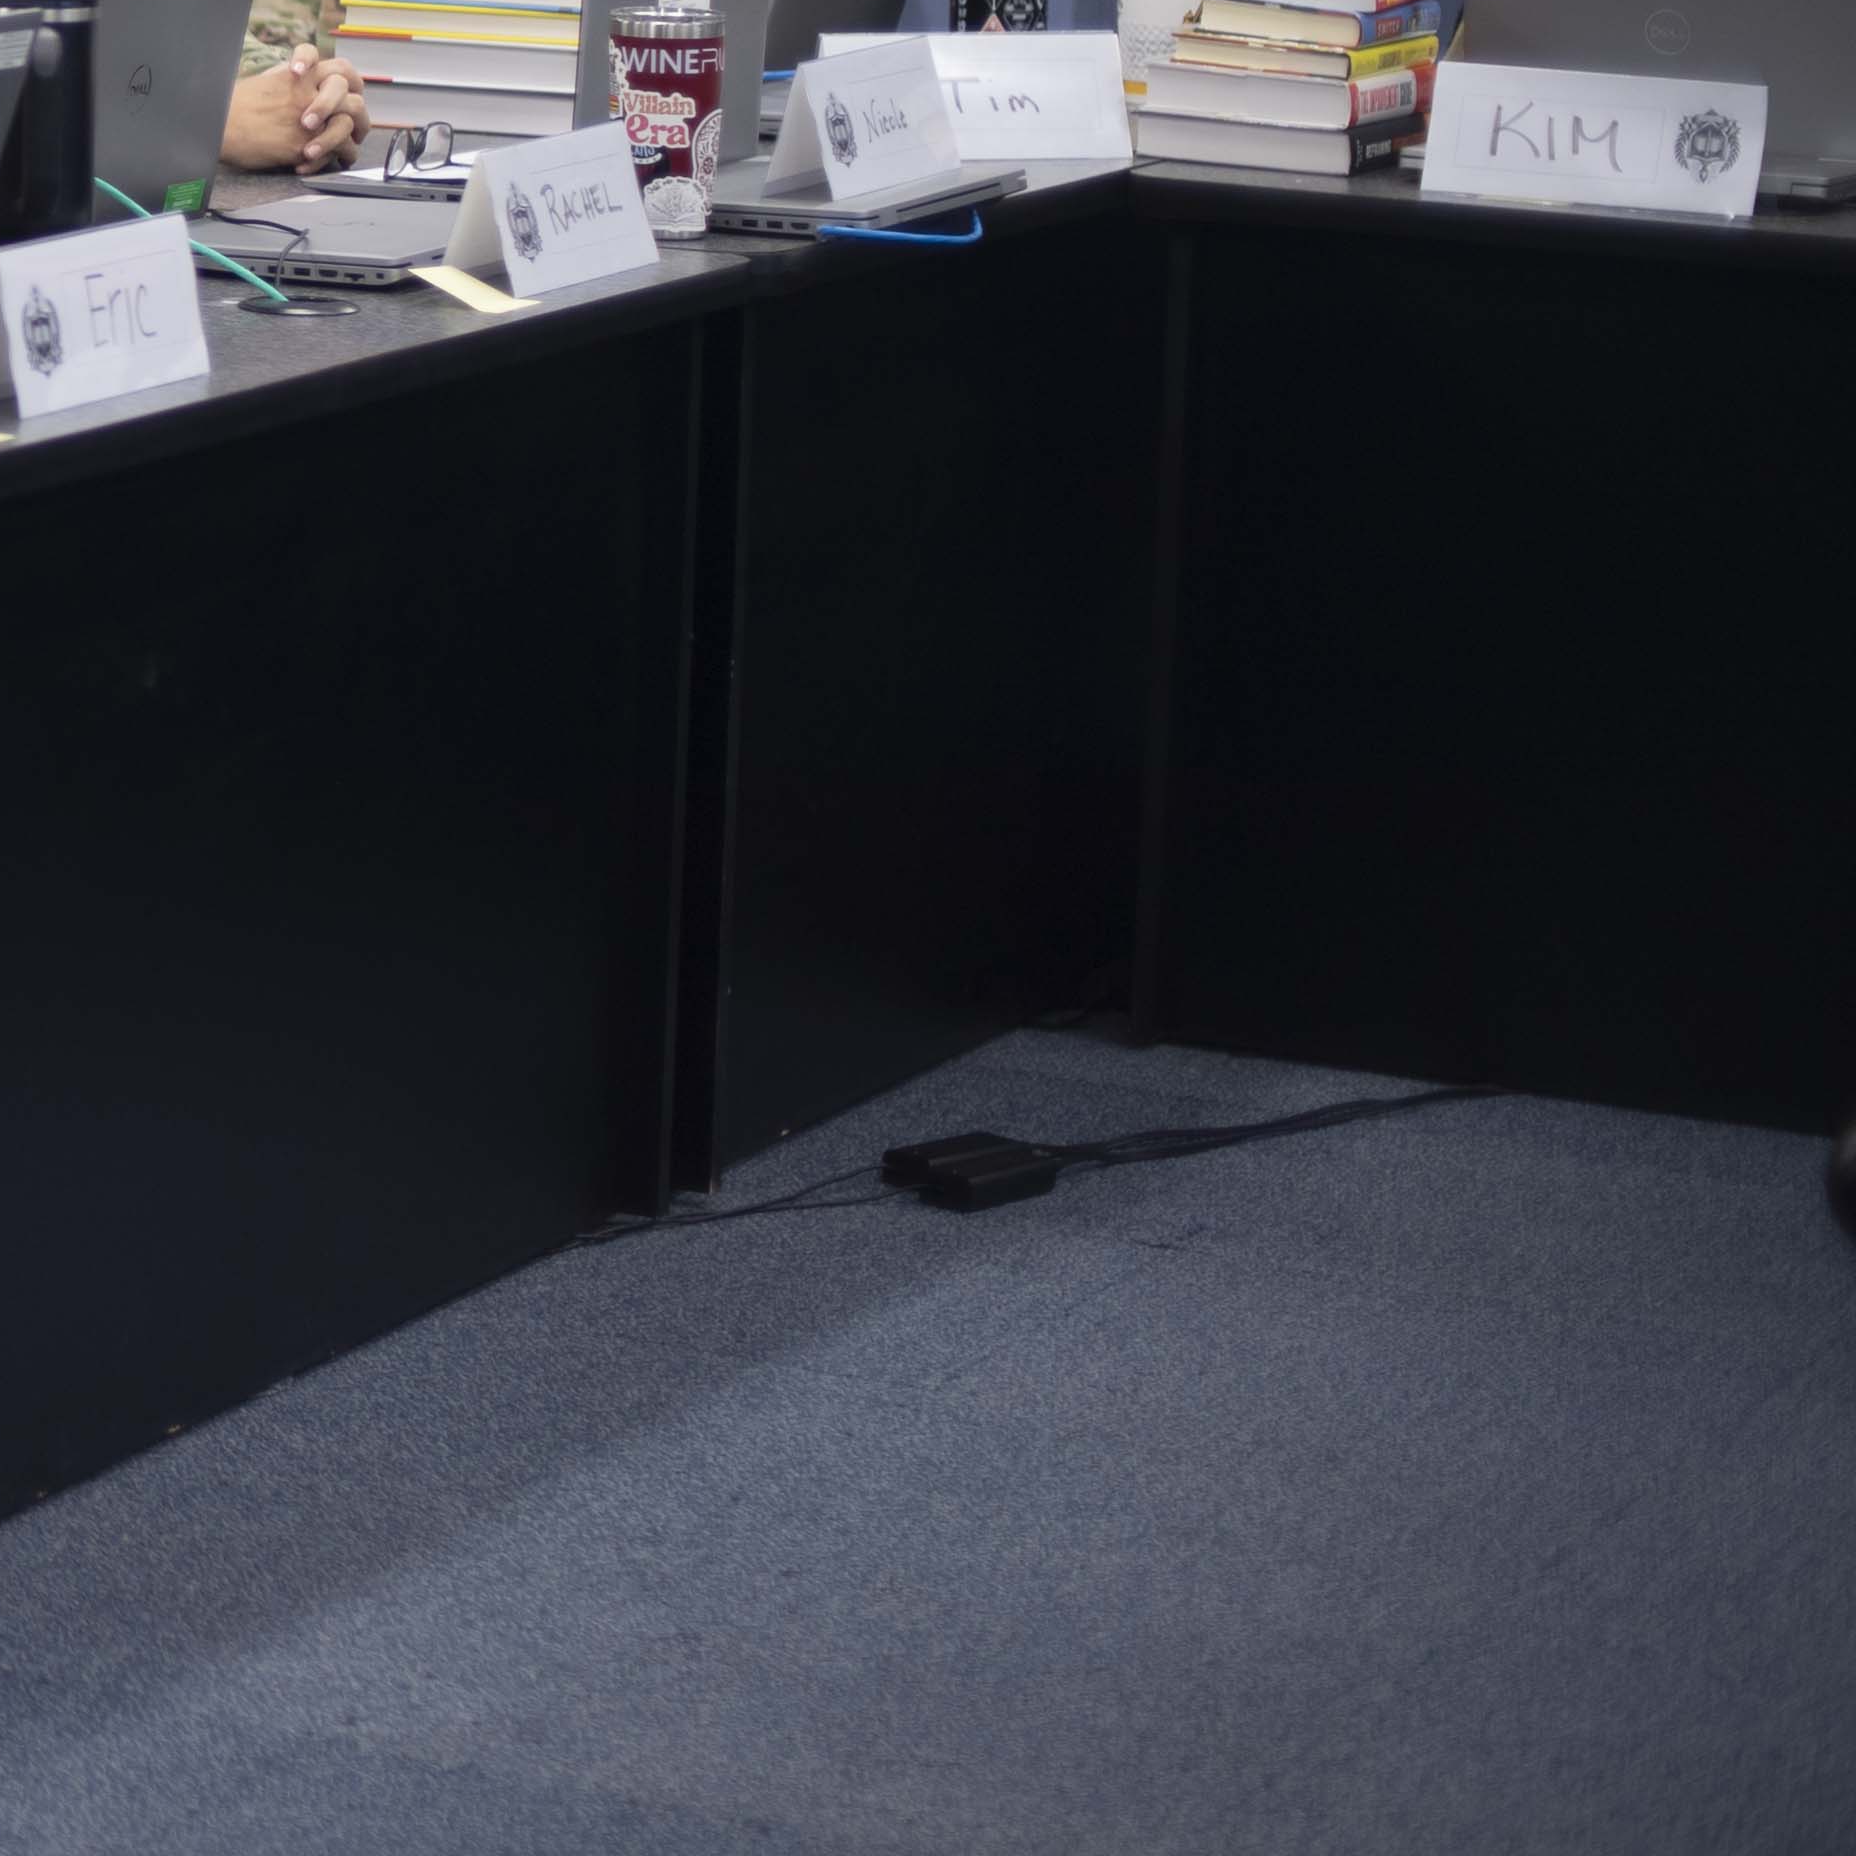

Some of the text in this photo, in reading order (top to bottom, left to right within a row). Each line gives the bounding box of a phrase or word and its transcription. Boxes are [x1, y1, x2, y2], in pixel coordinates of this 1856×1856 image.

[623, 92, 695, 116] Villain
[939, 76, 1041, 114] Tim
[625, 113, 688, 146] era
[862, 97, 908, 144] Nicole
[1489, 99, 1624, 174] KIM
[539, 180, 624, 237] RACHEL
[83, 272, 159, 348] Eric
